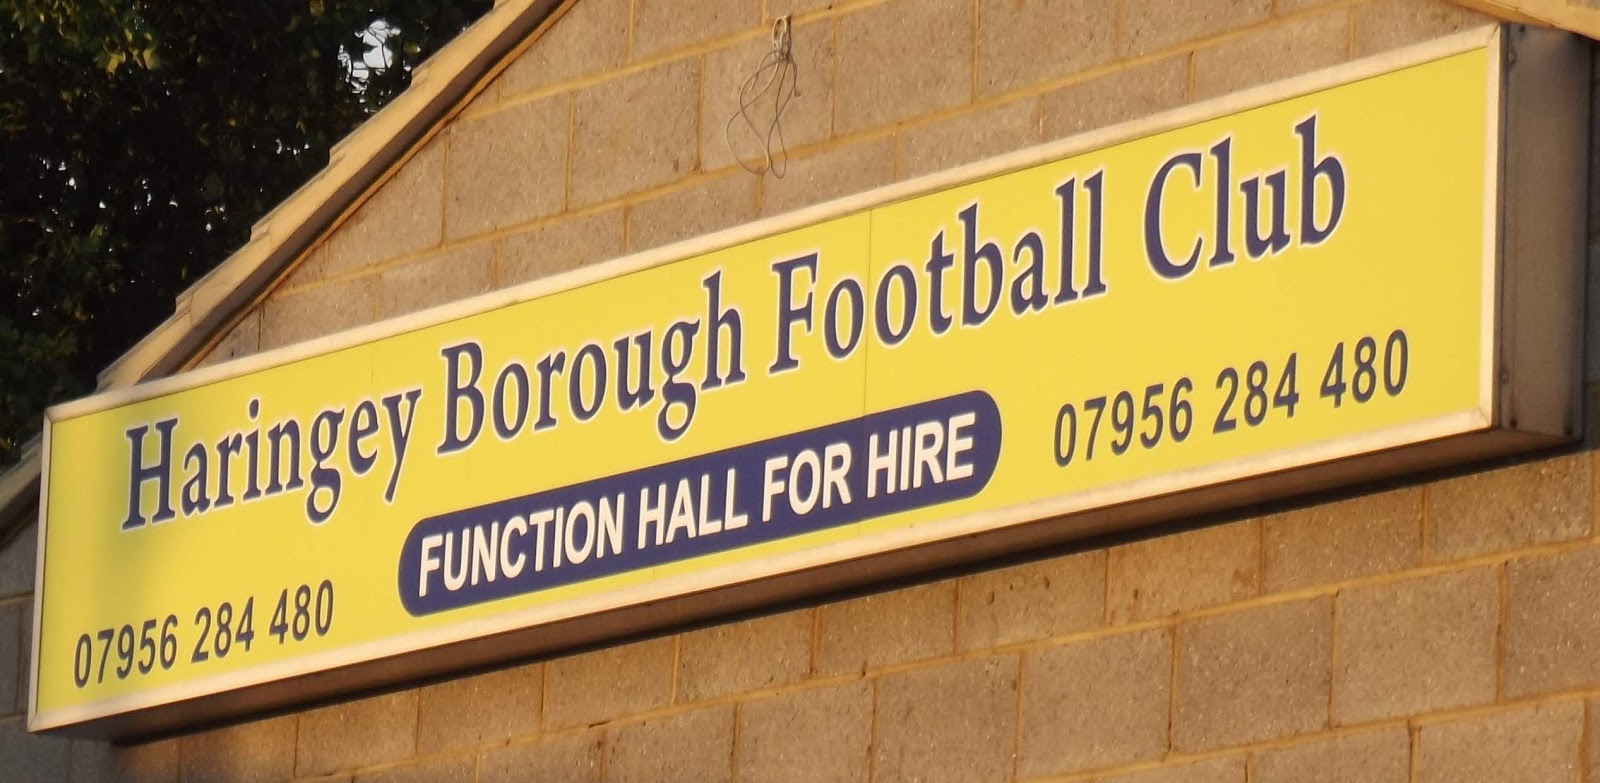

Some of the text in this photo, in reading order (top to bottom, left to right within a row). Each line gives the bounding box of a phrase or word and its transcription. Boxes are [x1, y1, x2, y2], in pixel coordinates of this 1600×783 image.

[121, 115, 1346, 530] Haringey Borough Football Club
[1054, 329, 1409, 467] 07956 284 480
[418, 411, 976, 597] FUNCTION HALL FOR HIRE
[74, 580, 334, 688] 07956 284 480
